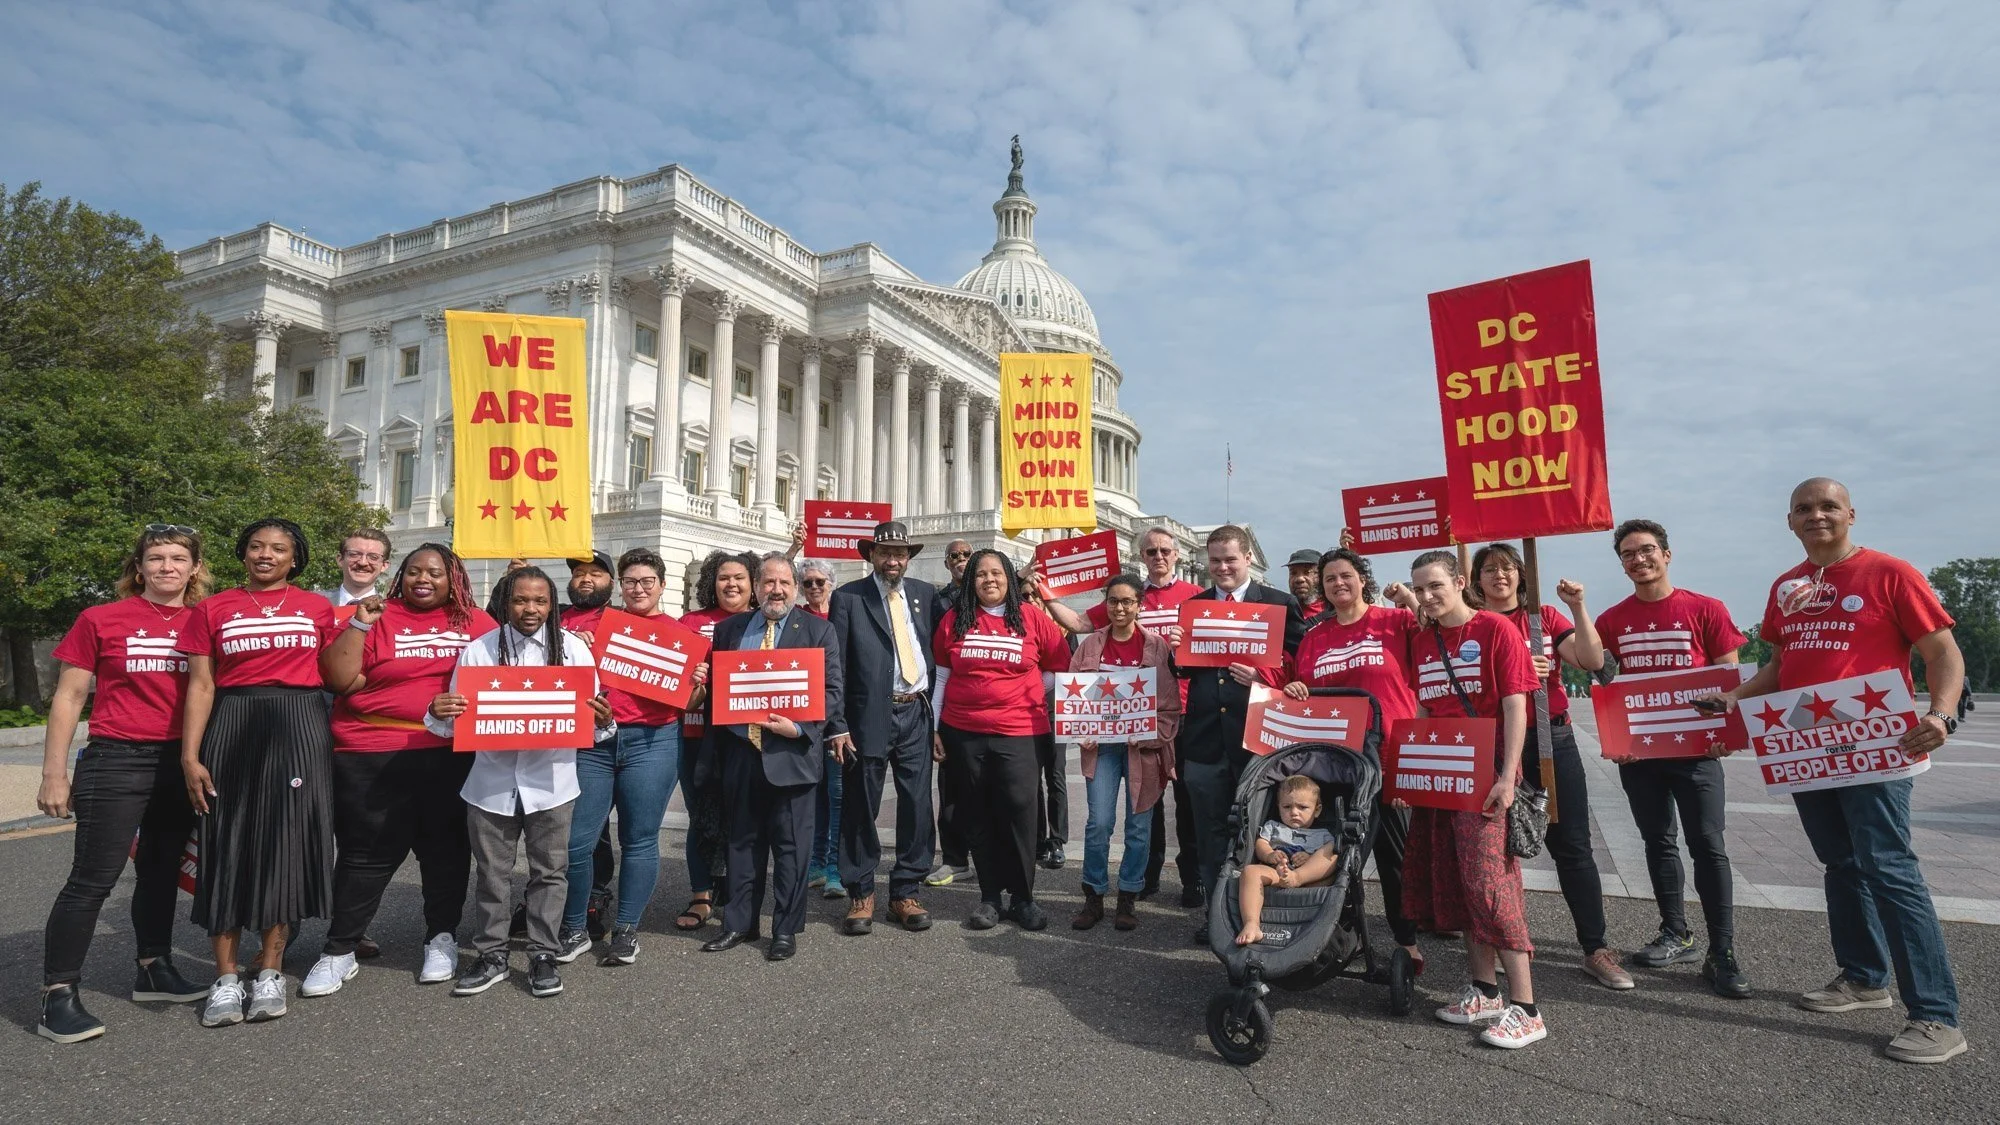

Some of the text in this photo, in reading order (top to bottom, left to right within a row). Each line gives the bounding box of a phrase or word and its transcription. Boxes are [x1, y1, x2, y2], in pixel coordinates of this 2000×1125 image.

[1477, 312, 1538, 348] DC
[482, 335, 556, 371] WE
[1445, 352, 1593, 400] STATE-
[470, 390, 573, 428] ARE
[1014, 402, 1079, 421] MIND
[1455, 404, 1578, 447] HOOD
[1013, 430, 1082, 450] YOUR
[489, 446, 558, 482] DC
[1019, 459, 1075, 478] OWN
[1471, 451, 1569, 491] NOW
[1007, 489, 1089, 509] STATE
[1361, 523, 1439, 543] HANDS OFF DC
[816, 537, 848, 549] HANDS
[1047, 567, 1109, 588] HANDS OFF DC
[221, 634, 317, 656] HANDS OFF DC
[1800, 631, 1819, 640] FOR
[395, 647, 435, 659] HANDS
[436, 647, 457, 658] OFF
[1190, 641, 1267, 655] HANDS OFF DC
[1789, 640, 1850, 651] STATEHOOD
[126, 658, 176, 673] HANDS
[960, 648, 1022, 664] HANDS OFF DC
[1654, 653, 1674, 667] OFF
[1675, 653, 1693, 667] DC
[599, 656, 680, 692] HANDS OFF DC
[1313, 655, 1384, 679] HANDS OFF DC
[1465, 680, 1482, 694] DC
[729, 694, 809, 711] HANDS OFF DC
[1062, 698, 1150, 715] STATEHOOD
[1624, 694, 1645, 709] DC
[1647, 692, 1672, 707] OFF
[475, 718, 576, 735] HANDS OFF DC
[1062, 719, 1150, 735] PEOPLE OF DC
[1763, 715, 1908, 755] STATEHOOD
[1825, 744, 1857, 755] for the
[1771, 754, 1852, 783] PEOPLE
[1852, 750, 1882, 772] OF
[1395, 773, 1475, 794] HANDS OFF DC
